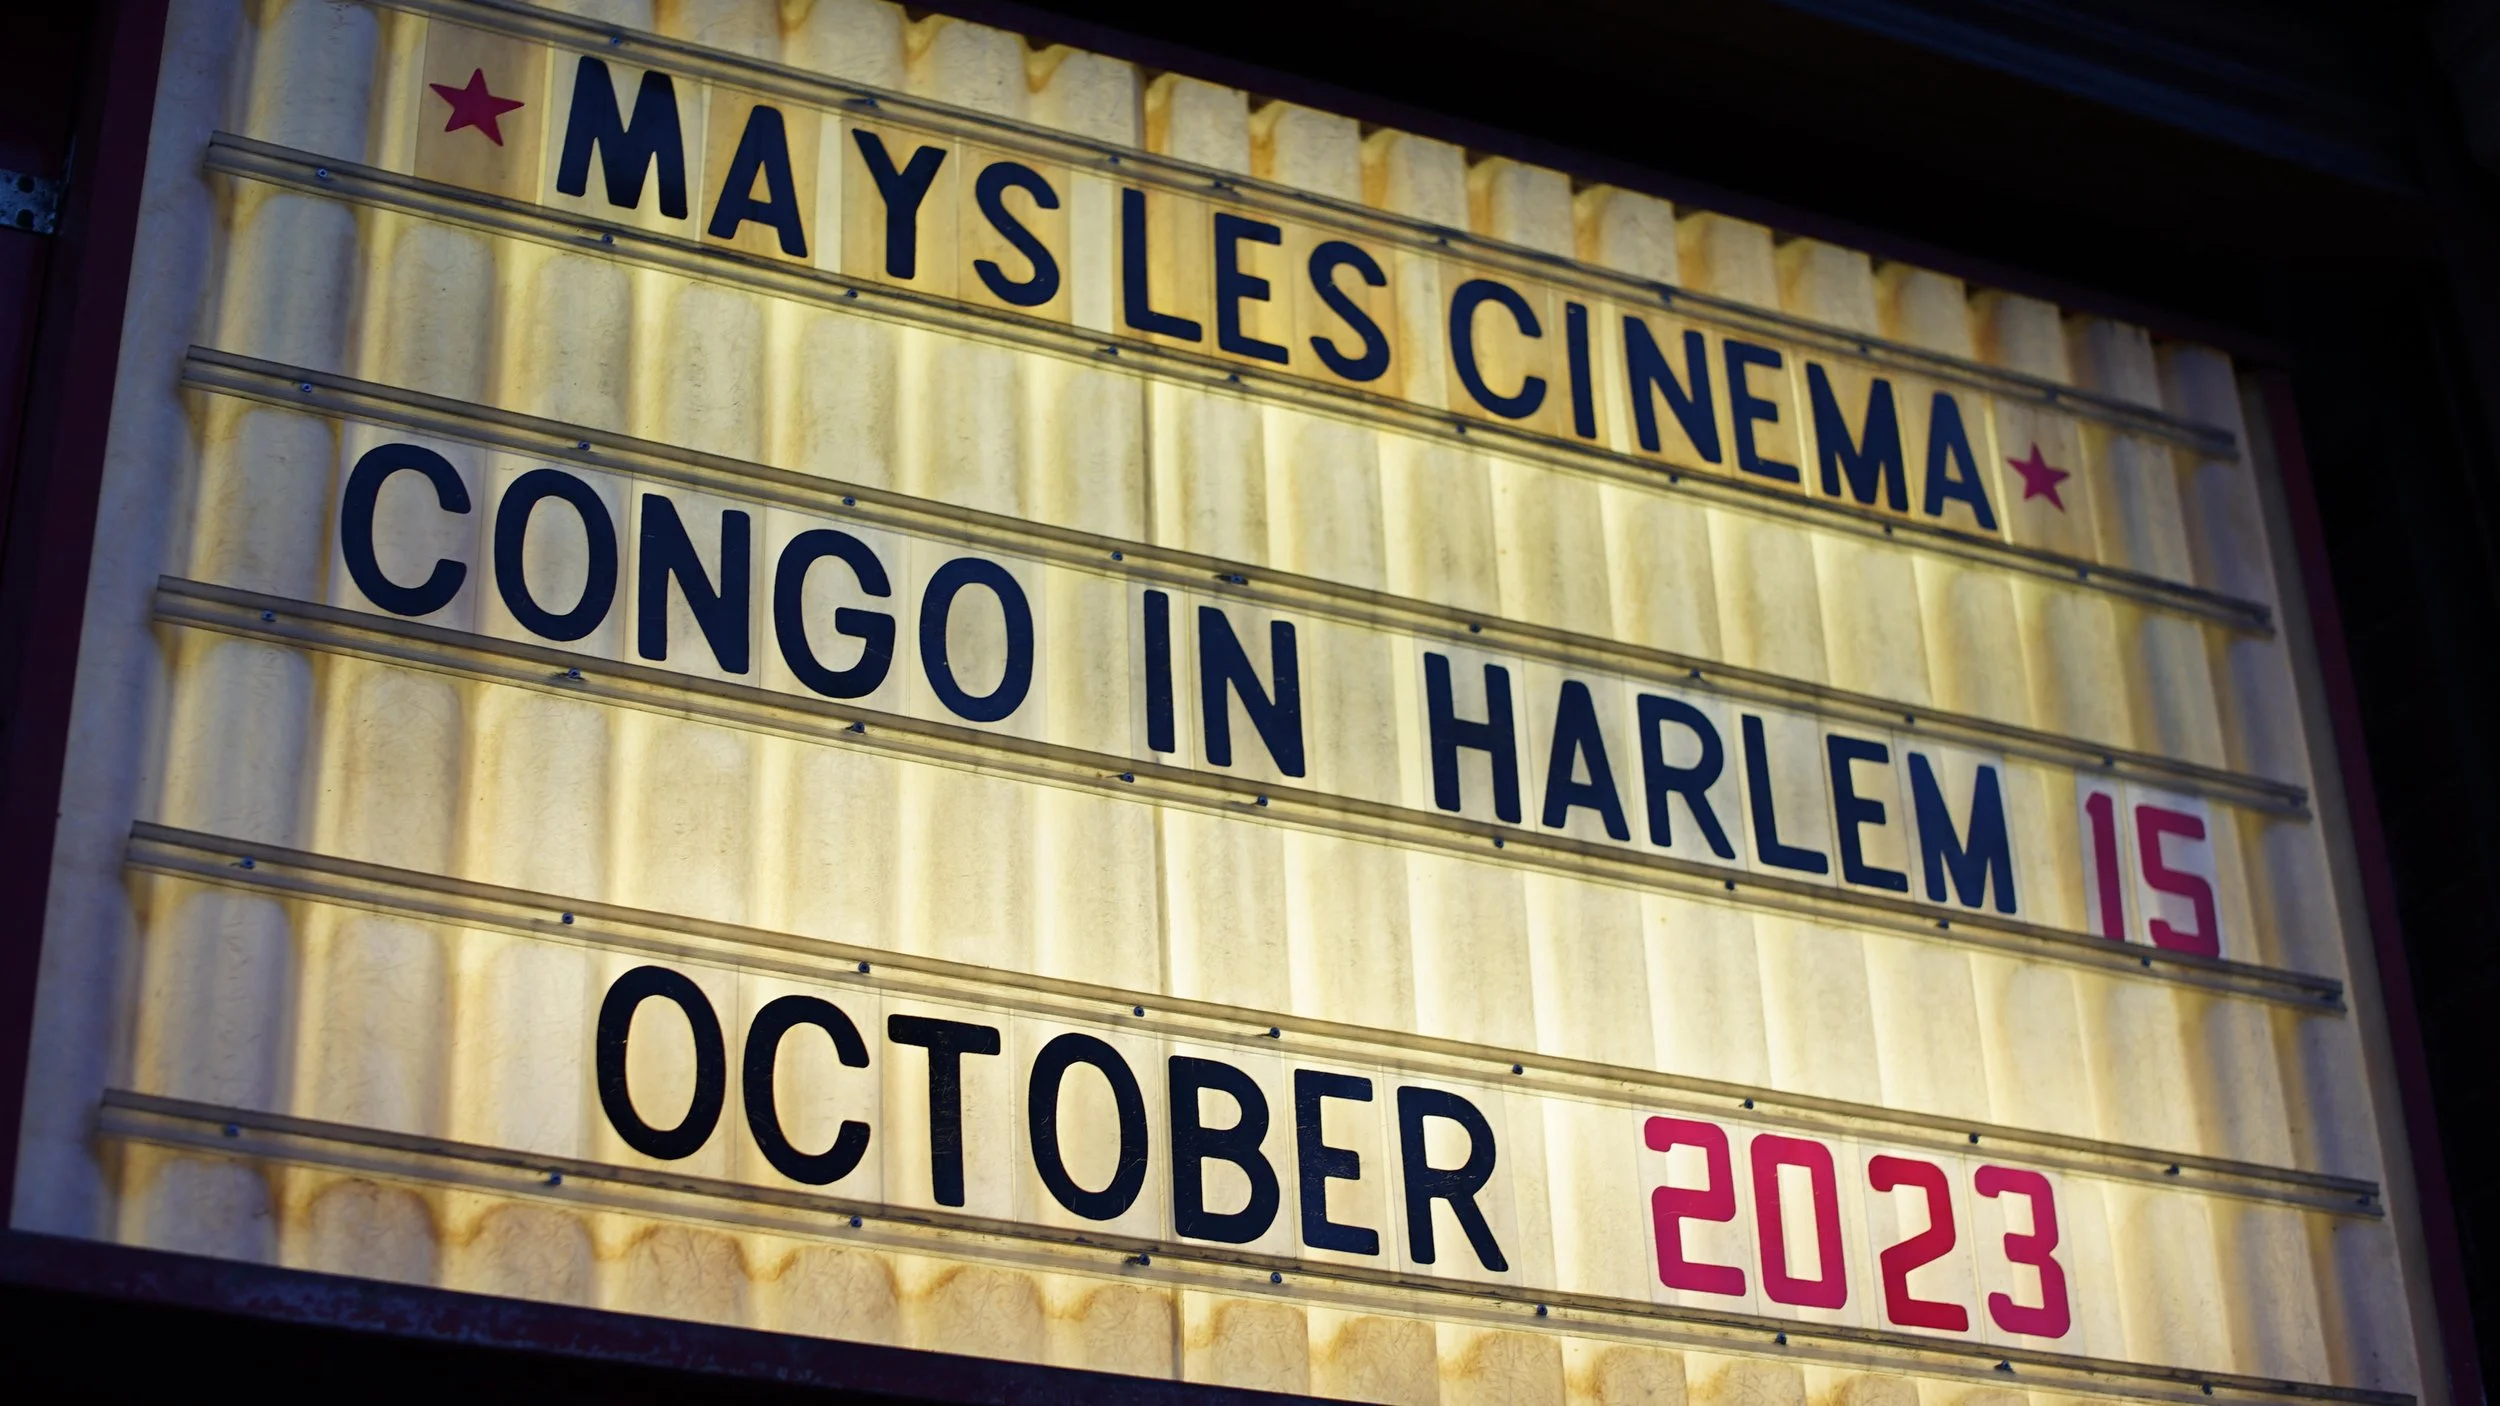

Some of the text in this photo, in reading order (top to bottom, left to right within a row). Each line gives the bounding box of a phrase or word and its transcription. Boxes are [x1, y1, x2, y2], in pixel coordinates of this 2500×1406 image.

[1451, 278, 1999, 532] CINEMA
[342, 443, 2219, 957] CONGO IN HARLEM 15
[598, 965, 2071, 1338] OCTOBER 2023
